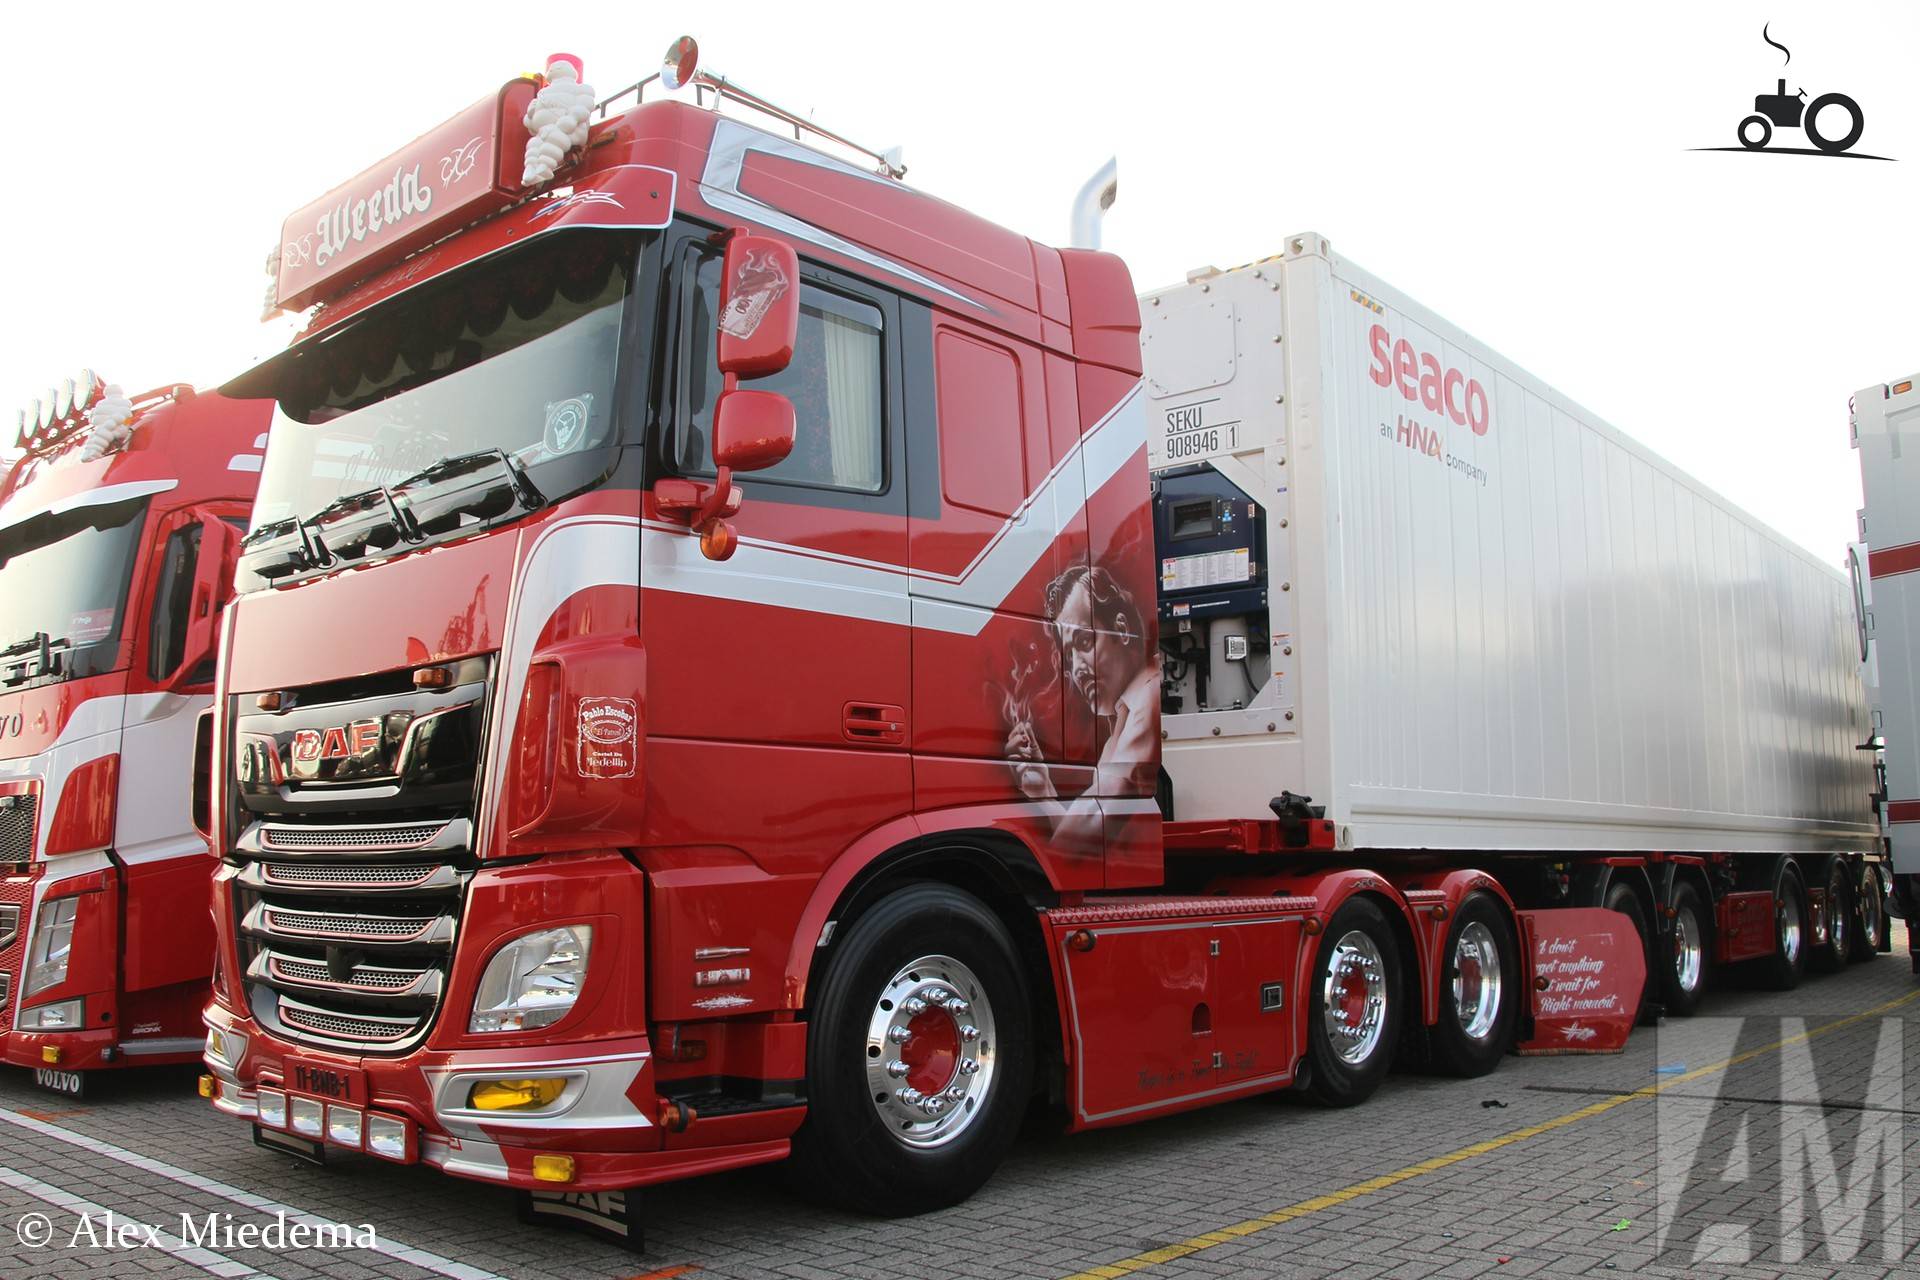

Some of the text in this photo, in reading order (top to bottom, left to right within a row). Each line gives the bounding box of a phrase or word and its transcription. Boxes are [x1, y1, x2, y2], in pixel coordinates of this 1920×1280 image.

[316, 163, 432, 266] Weeda
[1369, 324, 1489, 436] seaco
[1166, 406, 1202, 434] SEKU
[1167, 430, 1218, 459] 908946
[1380, 423, 1393, 440] an
[1446, 453, 1488, 487] company
[582, 706, 604, 721] Pablo
[294, 722, 381, 762] DAF
[1549, 938, 1577, 954] don't
[1559, 956, 1604, 975] anything
[1555, 976, 1583, 992] wait
[1580, 976, 1600, 995] for
[1540, 994, 1618, 1014] Right moment
[36, 1068, 80, 1092] VOLVO
